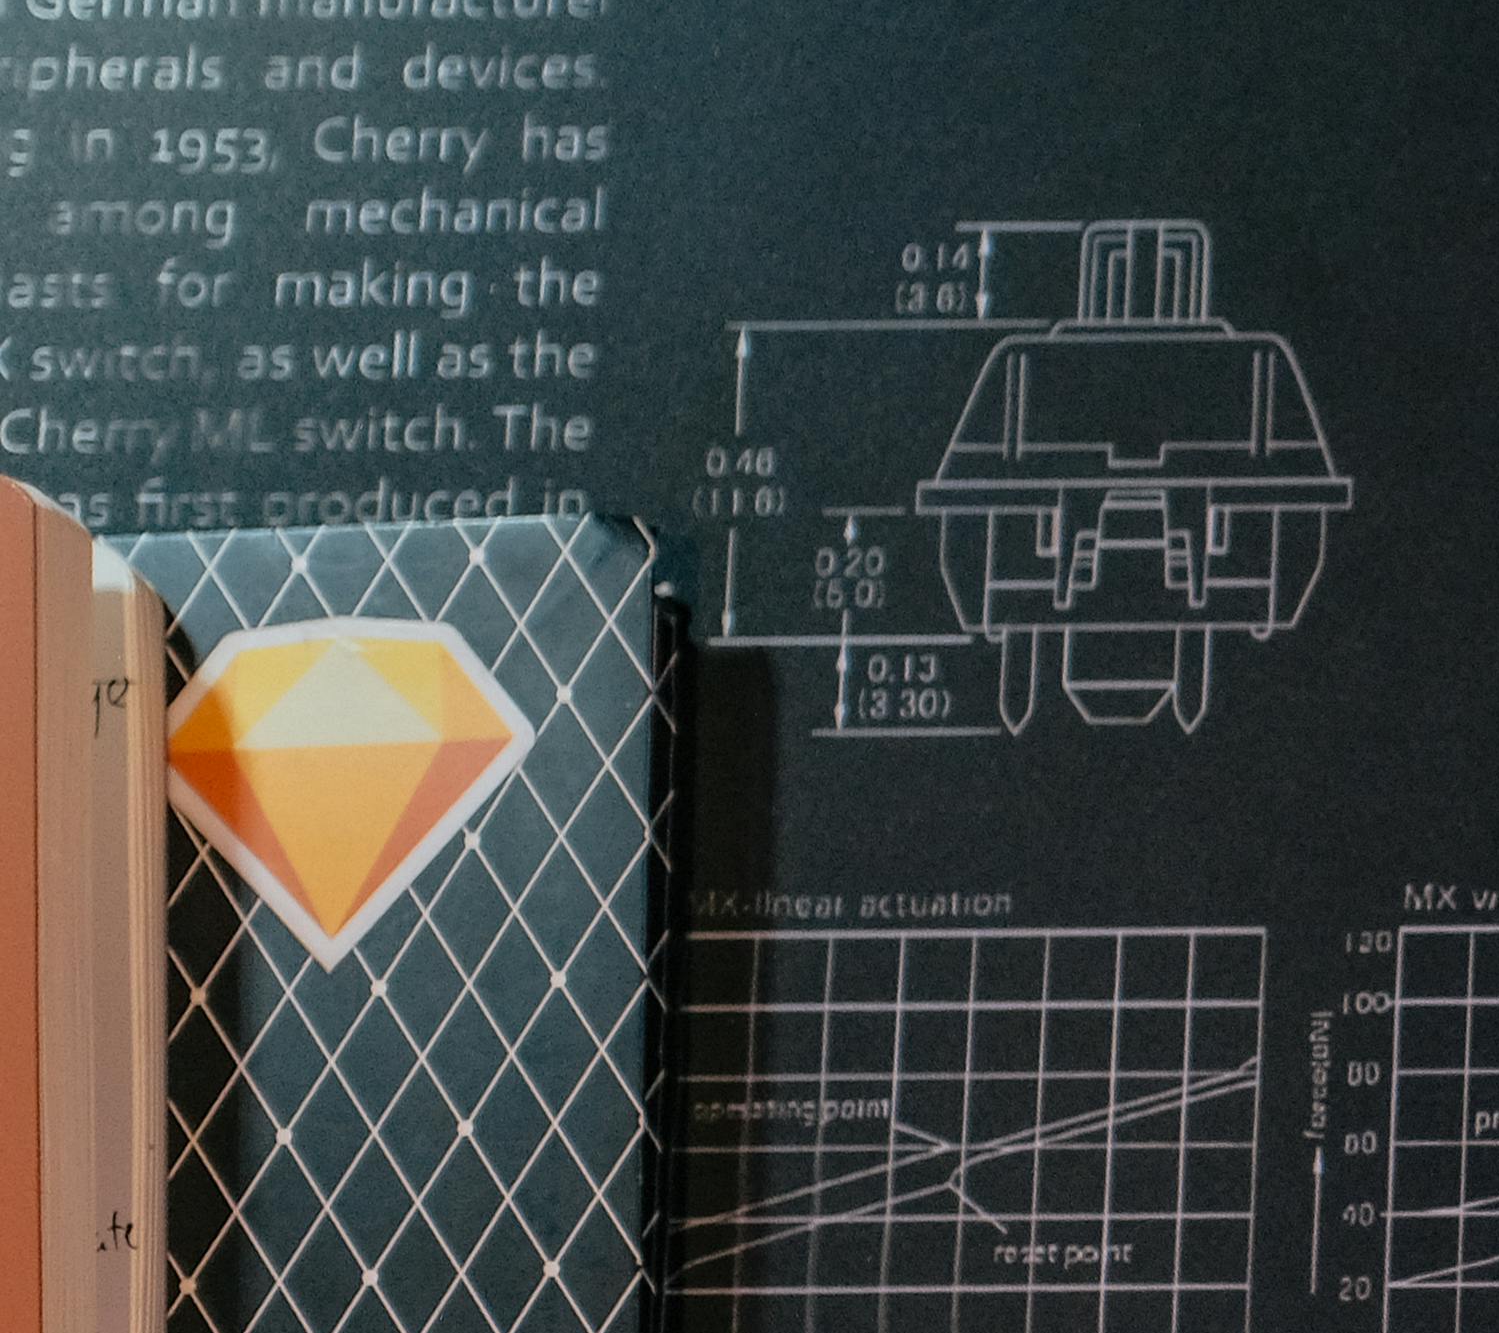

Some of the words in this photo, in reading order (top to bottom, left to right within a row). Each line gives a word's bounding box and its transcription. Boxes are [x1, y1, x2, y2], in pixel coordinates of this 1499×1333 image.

[264, 44, 361, 91] and
[151, 127, 279, 173] 1953,
[314, 114, 488, 176] Cherry
[522, 111, 610, 163] has
[51, 198, 236, 250] among
[306, 185, 607, 235] mechanical
[158, 258, 231, 308] for
[275, 260, 472, 318] making
[516, 256, 599, 308] the
[238, 344, 294, 381] as
[313, 329, 417, 379] well
[437, 342, 490, 380] as
[508, 329, 595, 380] the
[1, 406, 179, 464] Cherry
[295, 403, 479, 453] switch.
[493, 403, 592, 453] The
[137, 475, 238, 527] first
[262, 476, 515, 526] produced
[1402, 883, 1457, 912] MX
